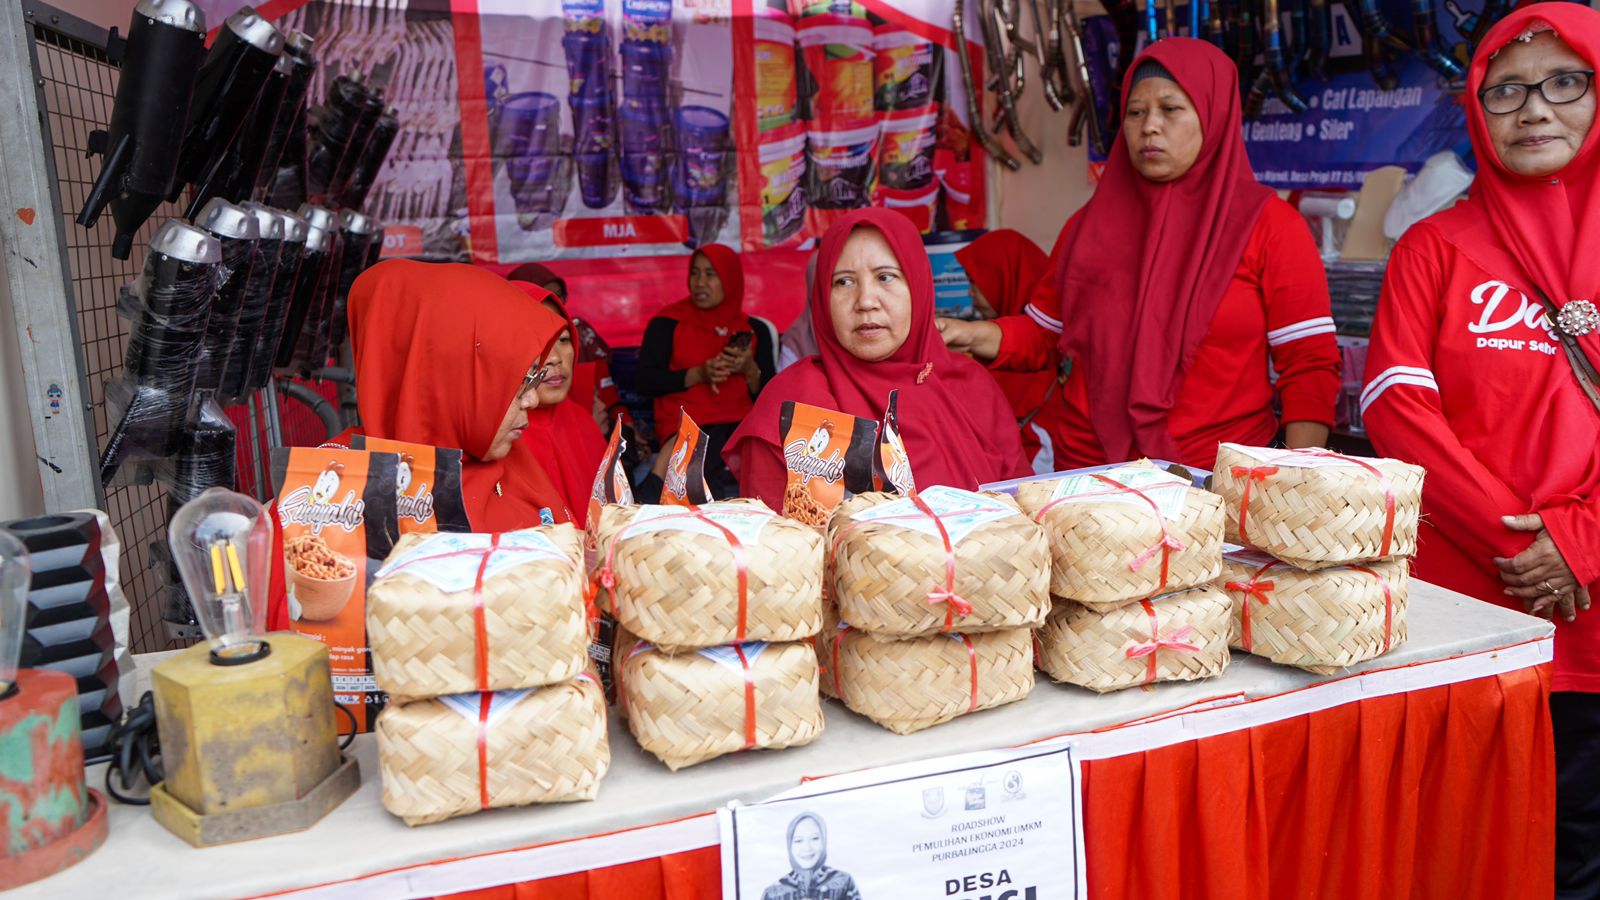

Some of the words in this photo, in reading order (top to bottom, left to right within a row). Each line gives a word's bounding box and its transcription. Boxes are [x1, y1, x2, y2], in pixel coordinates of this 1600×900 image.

[1322, 88, 1347, 110] Cat
[1348, 86, 1423, 111] Lapangan
[1251, 120, 1302, 142] Genteng
[1319, 119, 1354, 140] Siler
[383, 232, 406, 249] OT
[603, 223, 637, 238] MJA
[1476, 337, 1526, 350] Dapur
[951, 815, 1006, 833] ROADSHOW
[912, 836, 968, 853] PEMULIHAN
[969, 827, 1013, 843] EKONOMI
[1013, 821, 1042, 835] UMKM
[931, 843, 998, 862] PURBALINGGA
[999, 838, 1024, 850] 2024
[945, 869, 1013, 896] DESA
